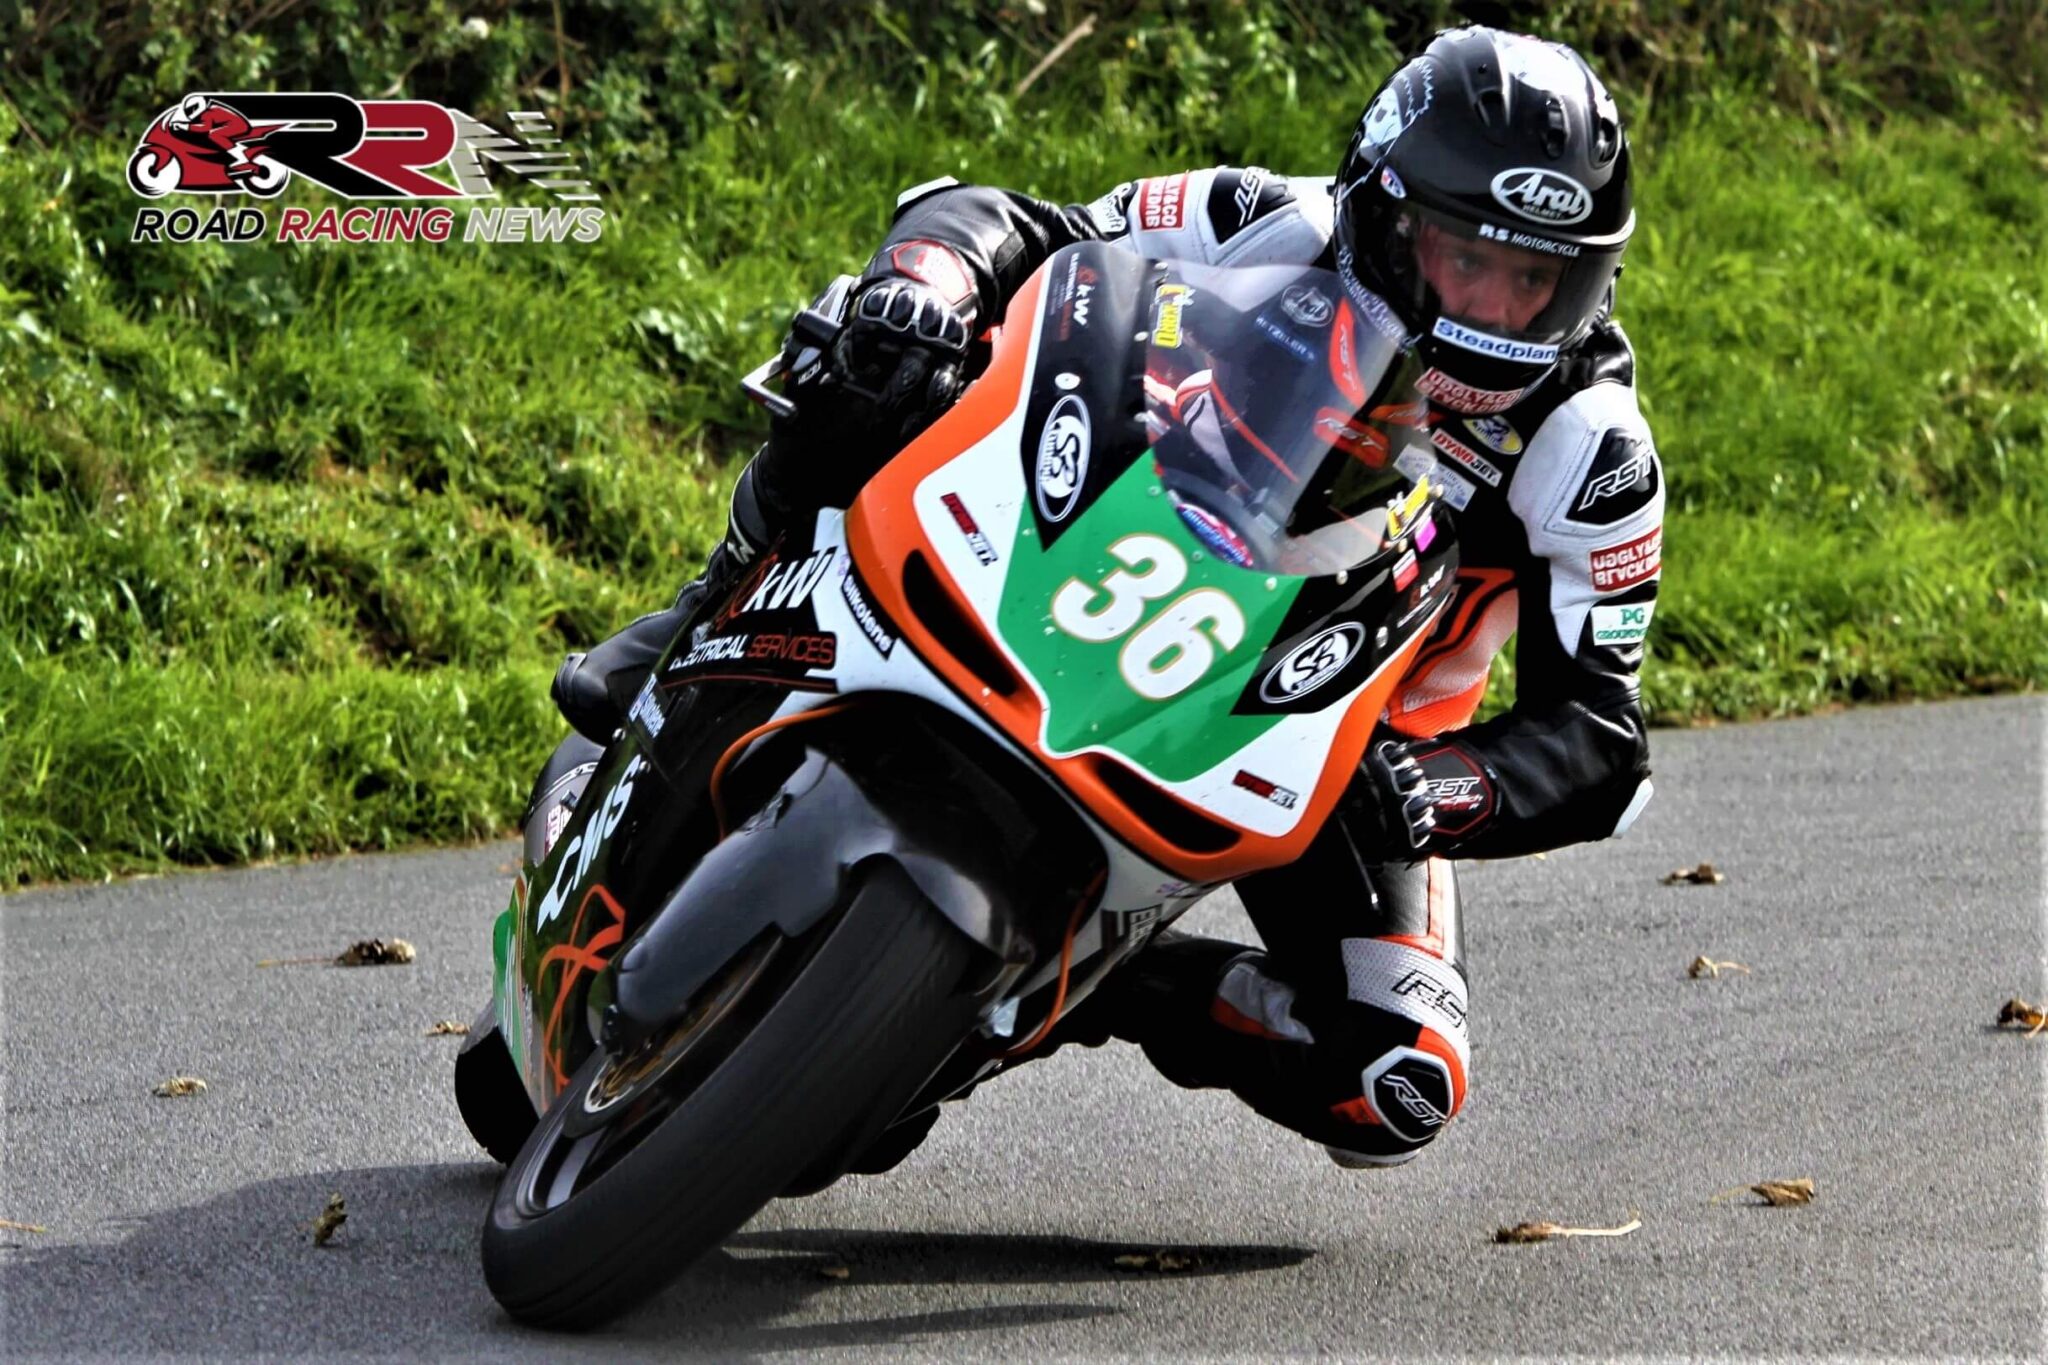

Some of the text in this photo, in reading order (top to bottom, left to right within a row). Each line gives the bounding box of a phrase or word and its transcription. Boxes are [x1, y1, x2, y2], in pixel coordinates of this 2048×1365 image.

[1499, 172, 1585, 215] Arai
[1478, 222, 1581, 257] RS MOTORCYCLE
[1438, 319, 1556, 361] Steadplan
[1578, 451, 1653, 512] RST
[1052, 532, 1246, 701] 36
[1620, 607, 1645, 625] PG
[746, 633, 835, 666] SERVICES
[1381, 1073, 1448, 1126] RST
